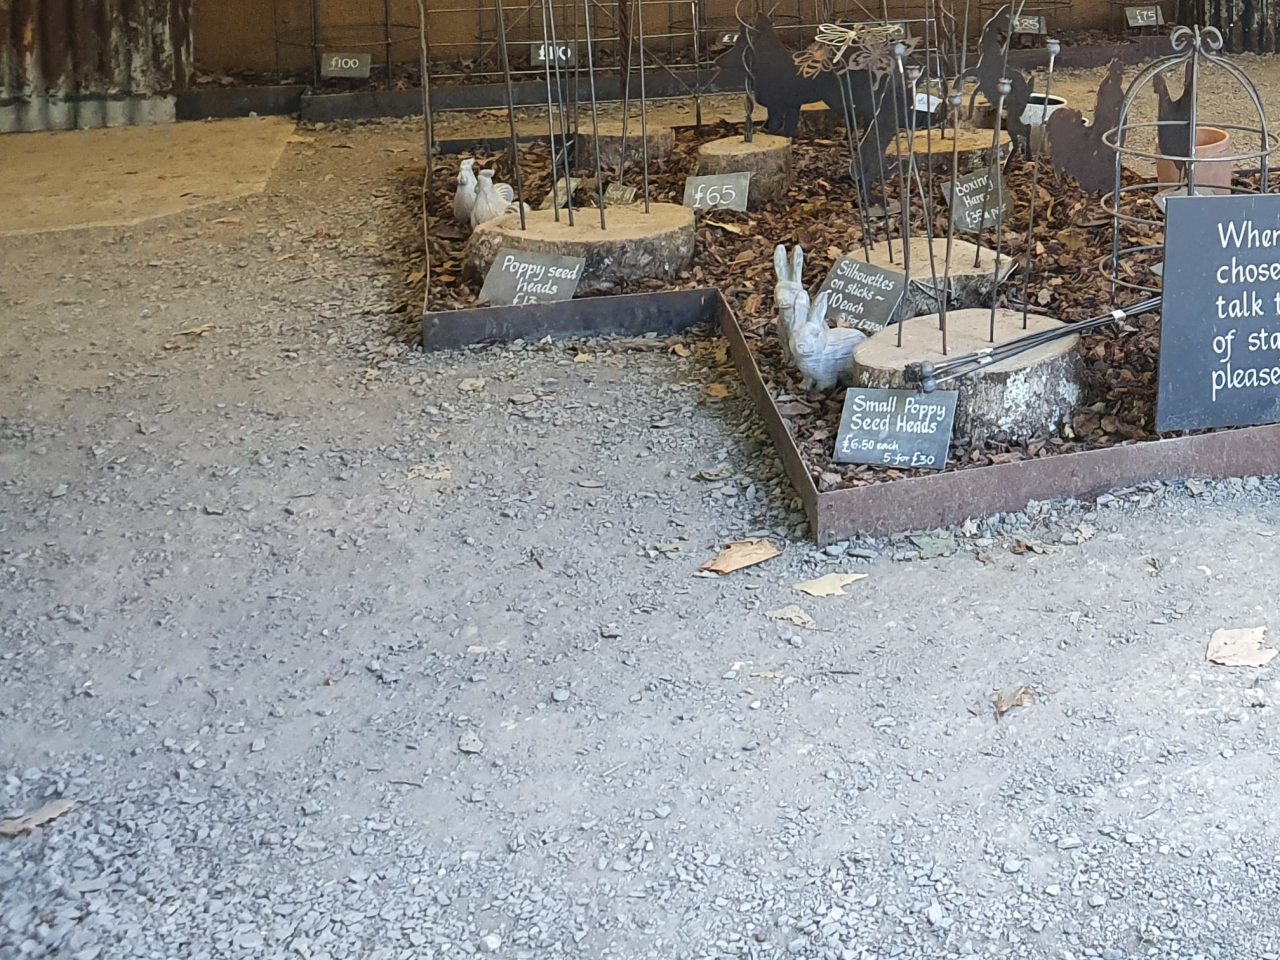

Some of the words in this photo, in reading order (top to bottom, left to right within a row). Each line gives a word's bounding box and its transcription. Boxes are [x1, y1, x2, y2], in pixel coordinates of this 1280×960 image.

[1136, 9, 1156, 23] £75
[328, 56, 359, 70] £100
[693, 184, 736, 207] £65
[502, 255, 545, 281] Poppy
[547, 264, 579, 280] seed
[837, 260, 895, 290] Silhouettes
[516, 277, 558, 294] heads
[830, 279, 844, 289] on
[845, 282, 874, 300] sticks
[840, 300, 864, 314] each
[1216, 291, 1264, 319] talk
[1212, 329, 1236, 363] of
[853, 395, 897, 413] Small
[904, 397, 946, 421] Poppy
[850, 414, 890, 431] Seed
[896, 415, 937, 434] Heads
[842, 434, 874, 452] £6.50
[877, 440, 898, 450] each
[883, 452, 891, 462] 5
[894, 452, 909, 464] for
[911, 452, 935, 465] £30
